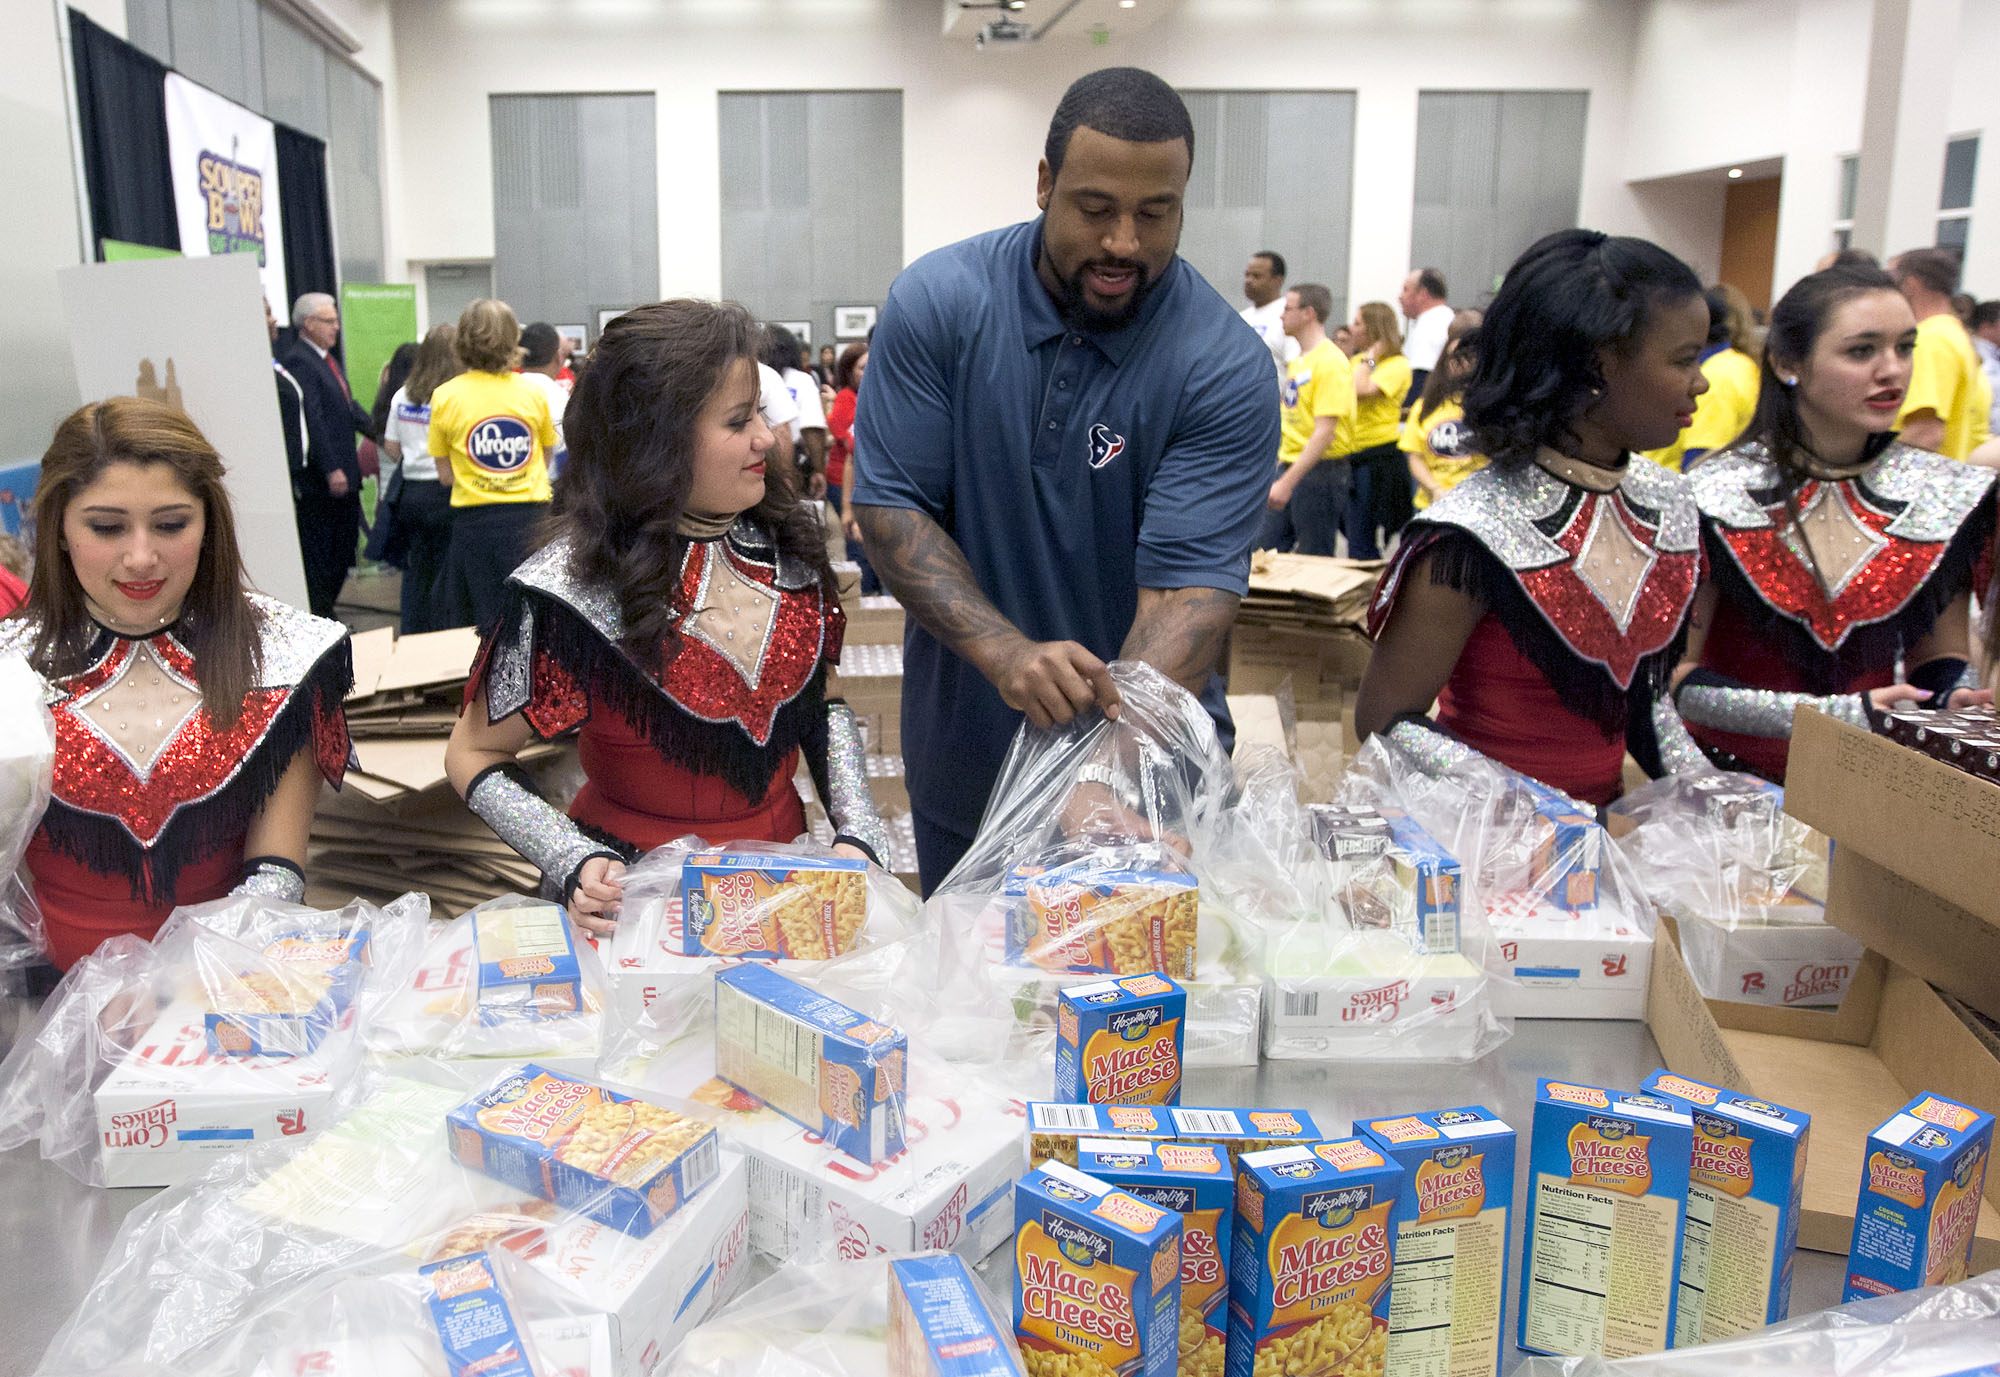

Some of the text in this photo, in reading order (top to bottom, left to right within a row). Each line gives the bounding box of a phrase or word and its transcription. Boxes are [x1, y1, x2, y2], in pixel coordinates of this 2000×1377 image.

[474, 423, 530, 467] Kroger
[717, 878, 747, 951] Mac &
[736, 874, 767, 951] Cheese
[823, 904, 833, 923] CHEESE
[1152, 920, 1161, 939] CHEESE
[1794, 963, 1849, 986] Corn
[1783, 979, 1841, 1003] Flakes
[1112, 1008, 1159, 1031] Hospitality
[1090, 1047, 1149, 1082] Mac
[1151, 1037, 1173, 1061] &
[484, 1076, 526, 1107] Hospitality
[1088, 1060, 1177, 1104] Cheese
[111, 1101, 178, 1131] Flakes
[498, 1080, 572, 1134] Mac &
[522, 1083, 591, 1142] Cheese
[559, 1102, 587, 1128] Dinner
[104, 1123, 169, 1149] Corn
[1592, 1117, 1633, 1133] Hospitality
[1162, 1149, 1194, 1158] Mac
[1162, 1157, 1217, 1167] Cheese
[1322, 1144, 1351, 1161] Mac
[1331, 1149, 1376, 1167] Cheese
[1573, 1139, 1645, 1162] Mac &
[1726, 1147, 1748, 1164] &
[1570, 1156, 1649, 1178] Cheese
[1690, 1153, 1749, 1179] heese
[1696, 1170, 1729, 1184] Dinner
[1872, 1163, 1922, 1188] Mac &
[1420, 1166, 1481, 1198] Mac &
[1594, 1175, 1628, 1185] Dinner
[1870, 1175, 1923, 1198] Cheese
[1308, 1188, 1368, 1217] Hospitality
[1418, 1181, 1482, 1214] Cheese
[1541, 1184, 1614, 1206] Nutrition Facts
[1689, 1187, 1715, 1202] Facts
[1099, 1204, 1157, 1226] Cheese
[1874, 1210, 1908, 1228] DIRECTIONS
[1878, 1206, 1905, 1220] COOKING
[1048, 1218, 1108, 1257] Hospitality
[1182, 1228, 1213, 1257] &
[1432, 1226, 1455, 1236] Facts
[1276, 1236, 1355, 1279] Mac
[1356, 1224, 1384, 1254] &
[1024, 1252, 1130, 1320] Mac &
[1273, 1250, 1387, 1308] Cheese
[1310, 1287, 1358, 1312] Dinner
[1022, 1286, 1134, 1347] Cheese
[1055, 1325, 1103, 1352] Dinner
